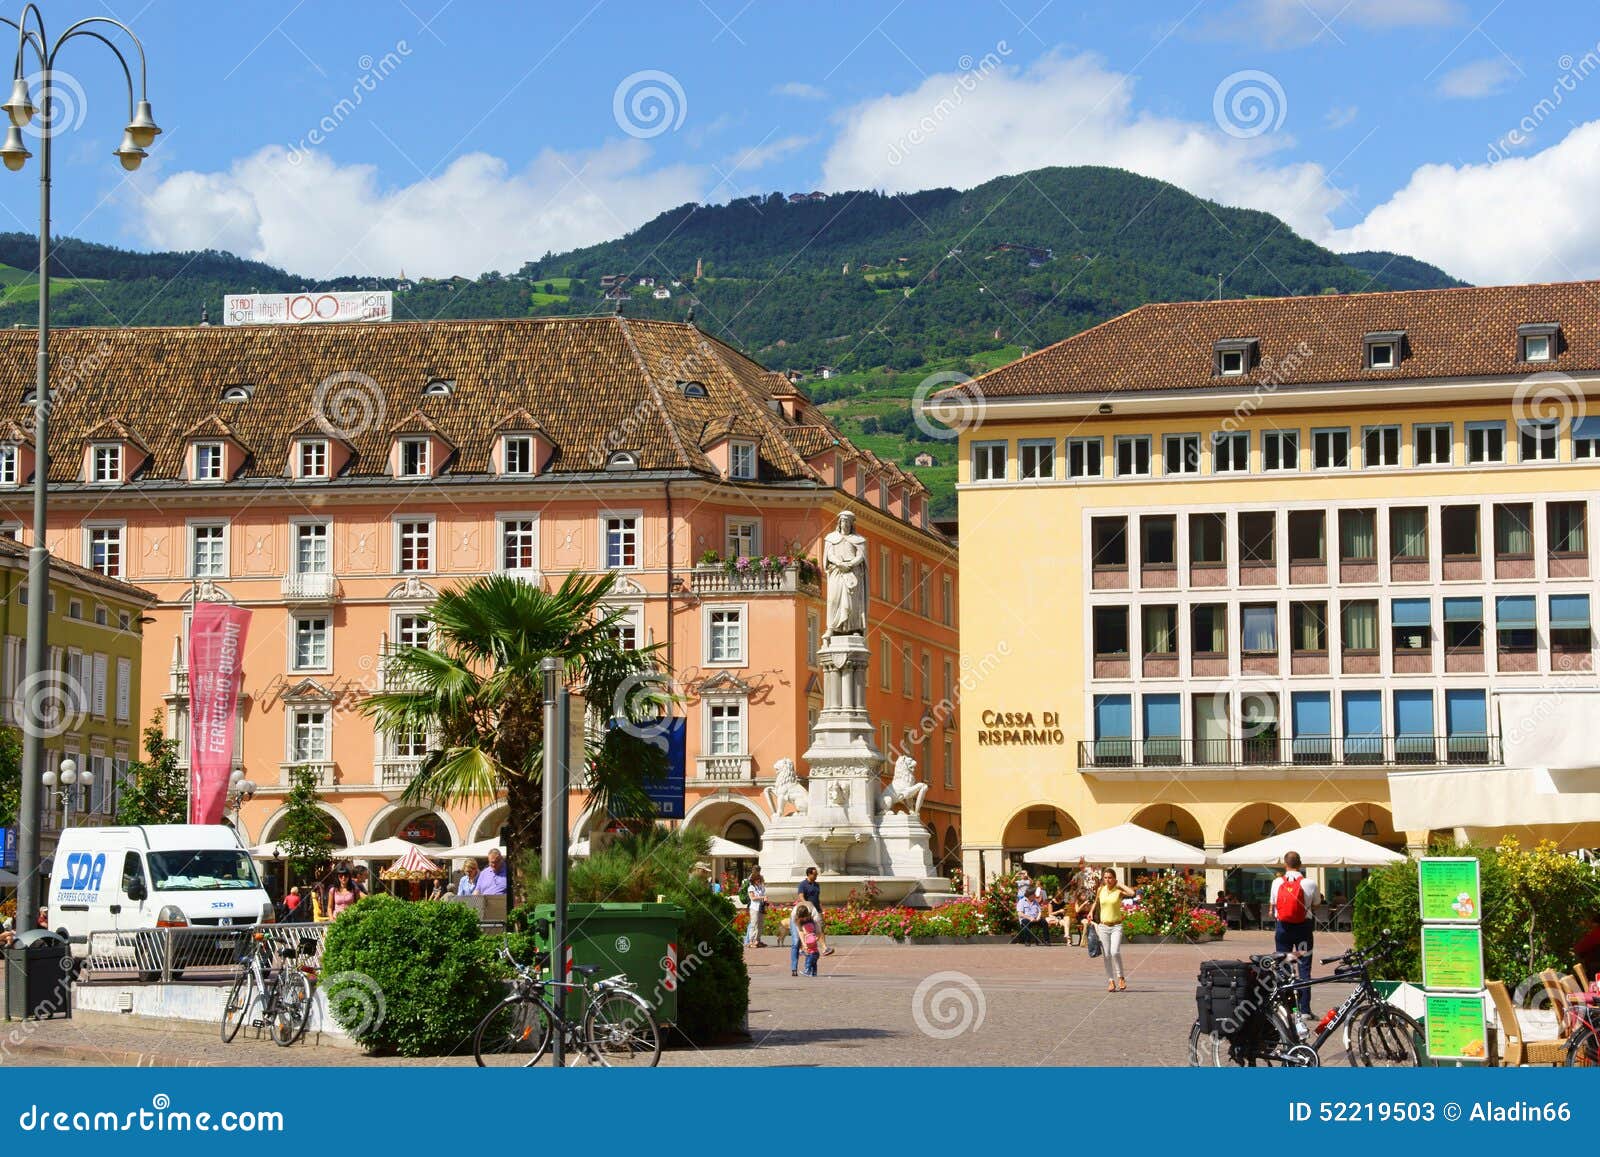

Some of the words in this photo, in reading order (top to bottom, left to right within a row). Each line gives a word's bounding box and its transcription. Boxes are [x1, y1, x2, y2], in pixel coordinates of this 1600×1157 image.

[230, 298, 254, 310] STADT
[284, 295, 339, 320] 100
[362, 295, 387, 307] HOTEL
[230, 310, 255, 322] HOTEL
[218, 622, 241, 675] BUSONI
[209, 678, 234, 753] FERRUCCIO
[981, 709, 1036, 728] CASSA
[1043, 711, 1060, 728] DI
[978, 729, 1064, 746] RISPARMIO
[60, 853, 106, 891] SDA
